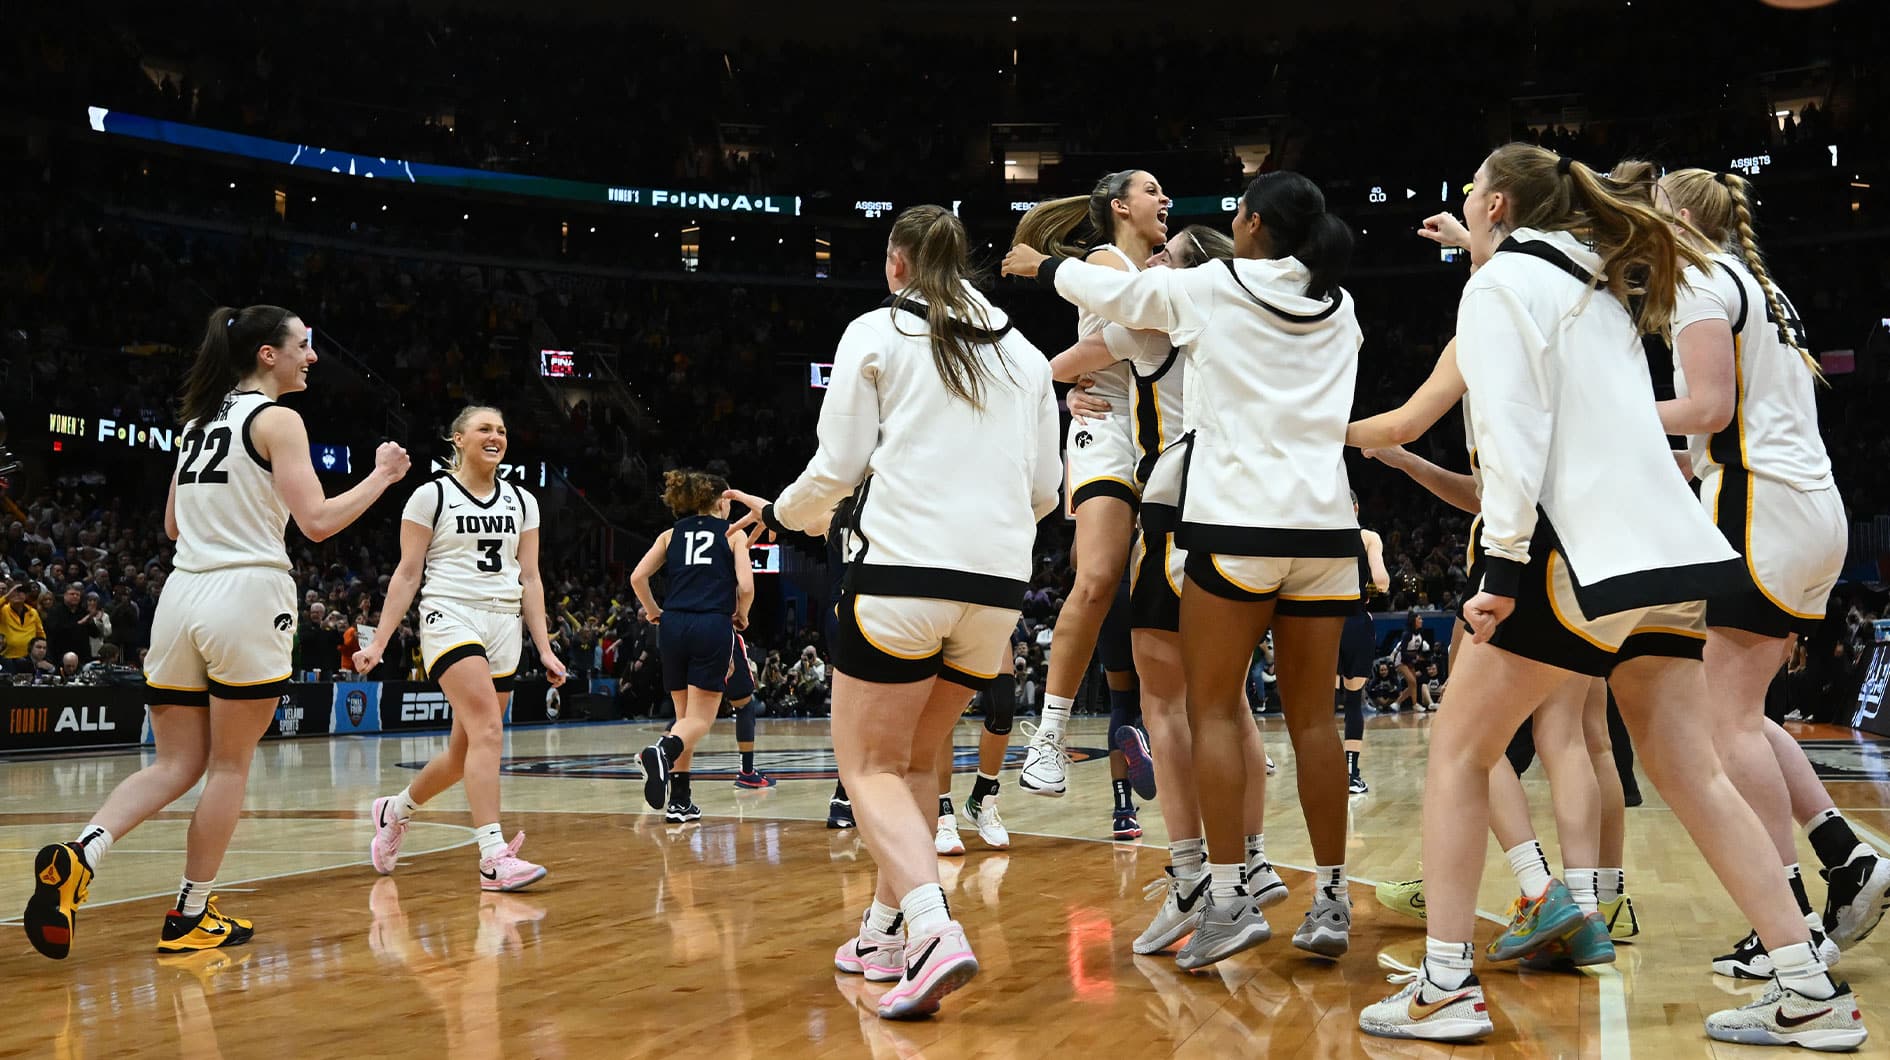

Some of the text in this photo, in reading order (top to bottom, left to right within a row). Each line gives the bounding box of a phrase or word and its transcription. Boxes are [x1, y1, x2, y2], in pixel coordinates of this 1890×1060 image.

[1730, 155, 1771, 168] ASSISTS
[1742, 165, 1760, 175] 12
[608, 188, 640, 203] WOMEN'S
[855, 201, 893, 210] ASSISTS
[865, 209, 881, 218] 21
[50, 413, 85, 437] WOMEN'S
[178, 426, 232, 486] 22
[456, 516, 516, 534] IOWA
[477, 539, 503, 573] 3
[684, 531, 715, 566] 12
[54, 706, 115, 732] ALL
